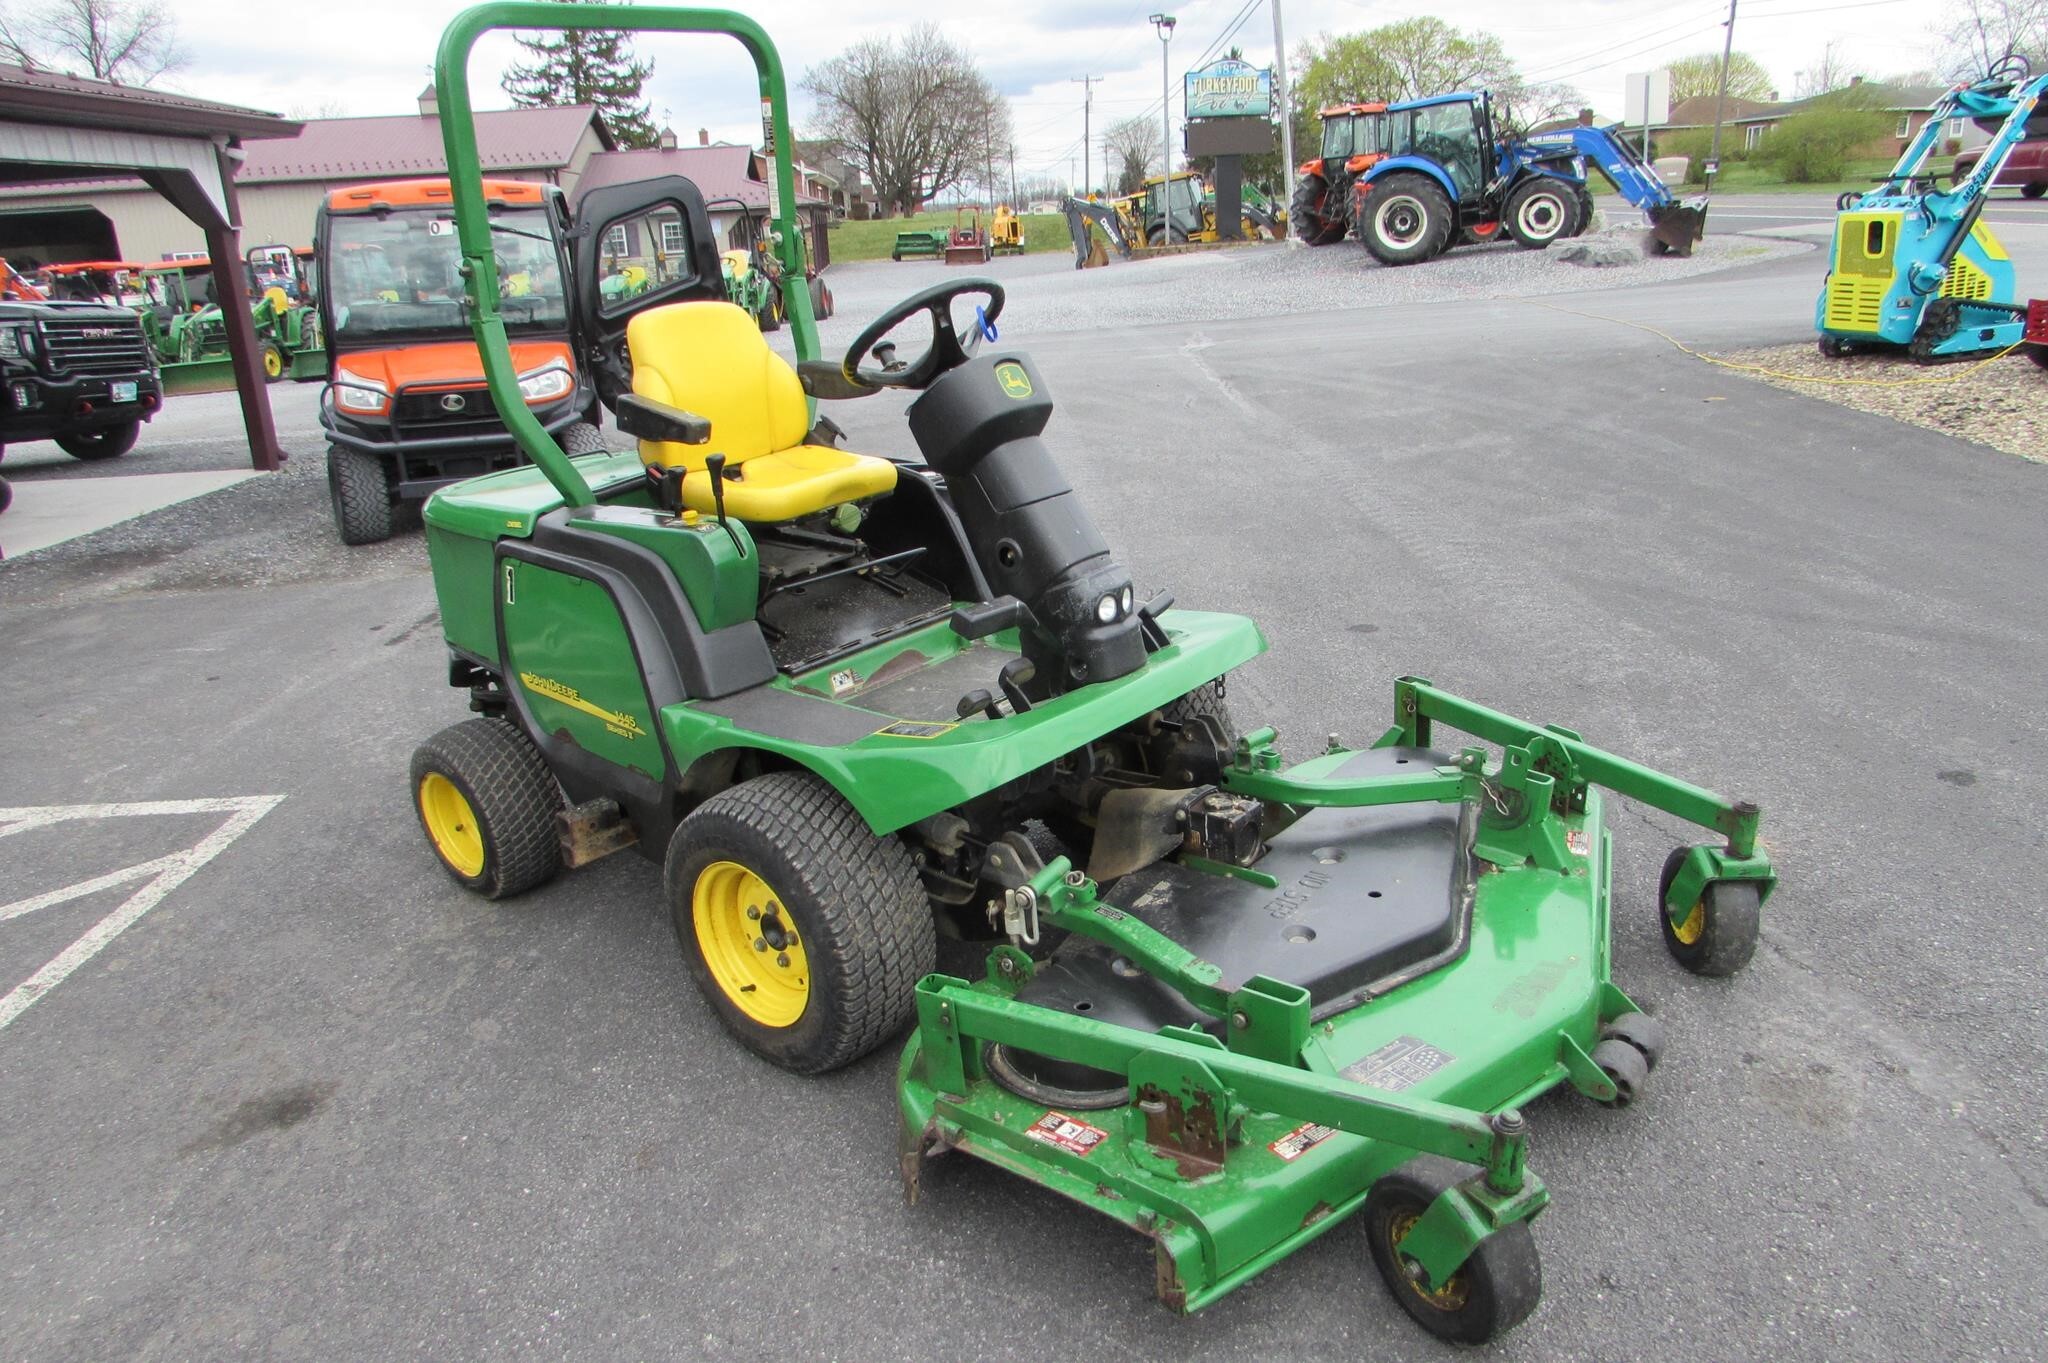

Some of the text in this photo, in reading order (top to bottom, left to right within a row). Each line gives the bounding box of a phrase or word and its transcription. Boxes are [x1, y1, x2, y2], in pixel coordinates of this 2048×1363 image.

[1192, 76, 1259, 96] TURKEYFOOT
[1543, 134, 1574, 142] HOLLAND
[1962, 161, 1992, 202] MPS330
[1100, 217, 1120, 244] DEERE
[615, 711, 636, 728] 1445
